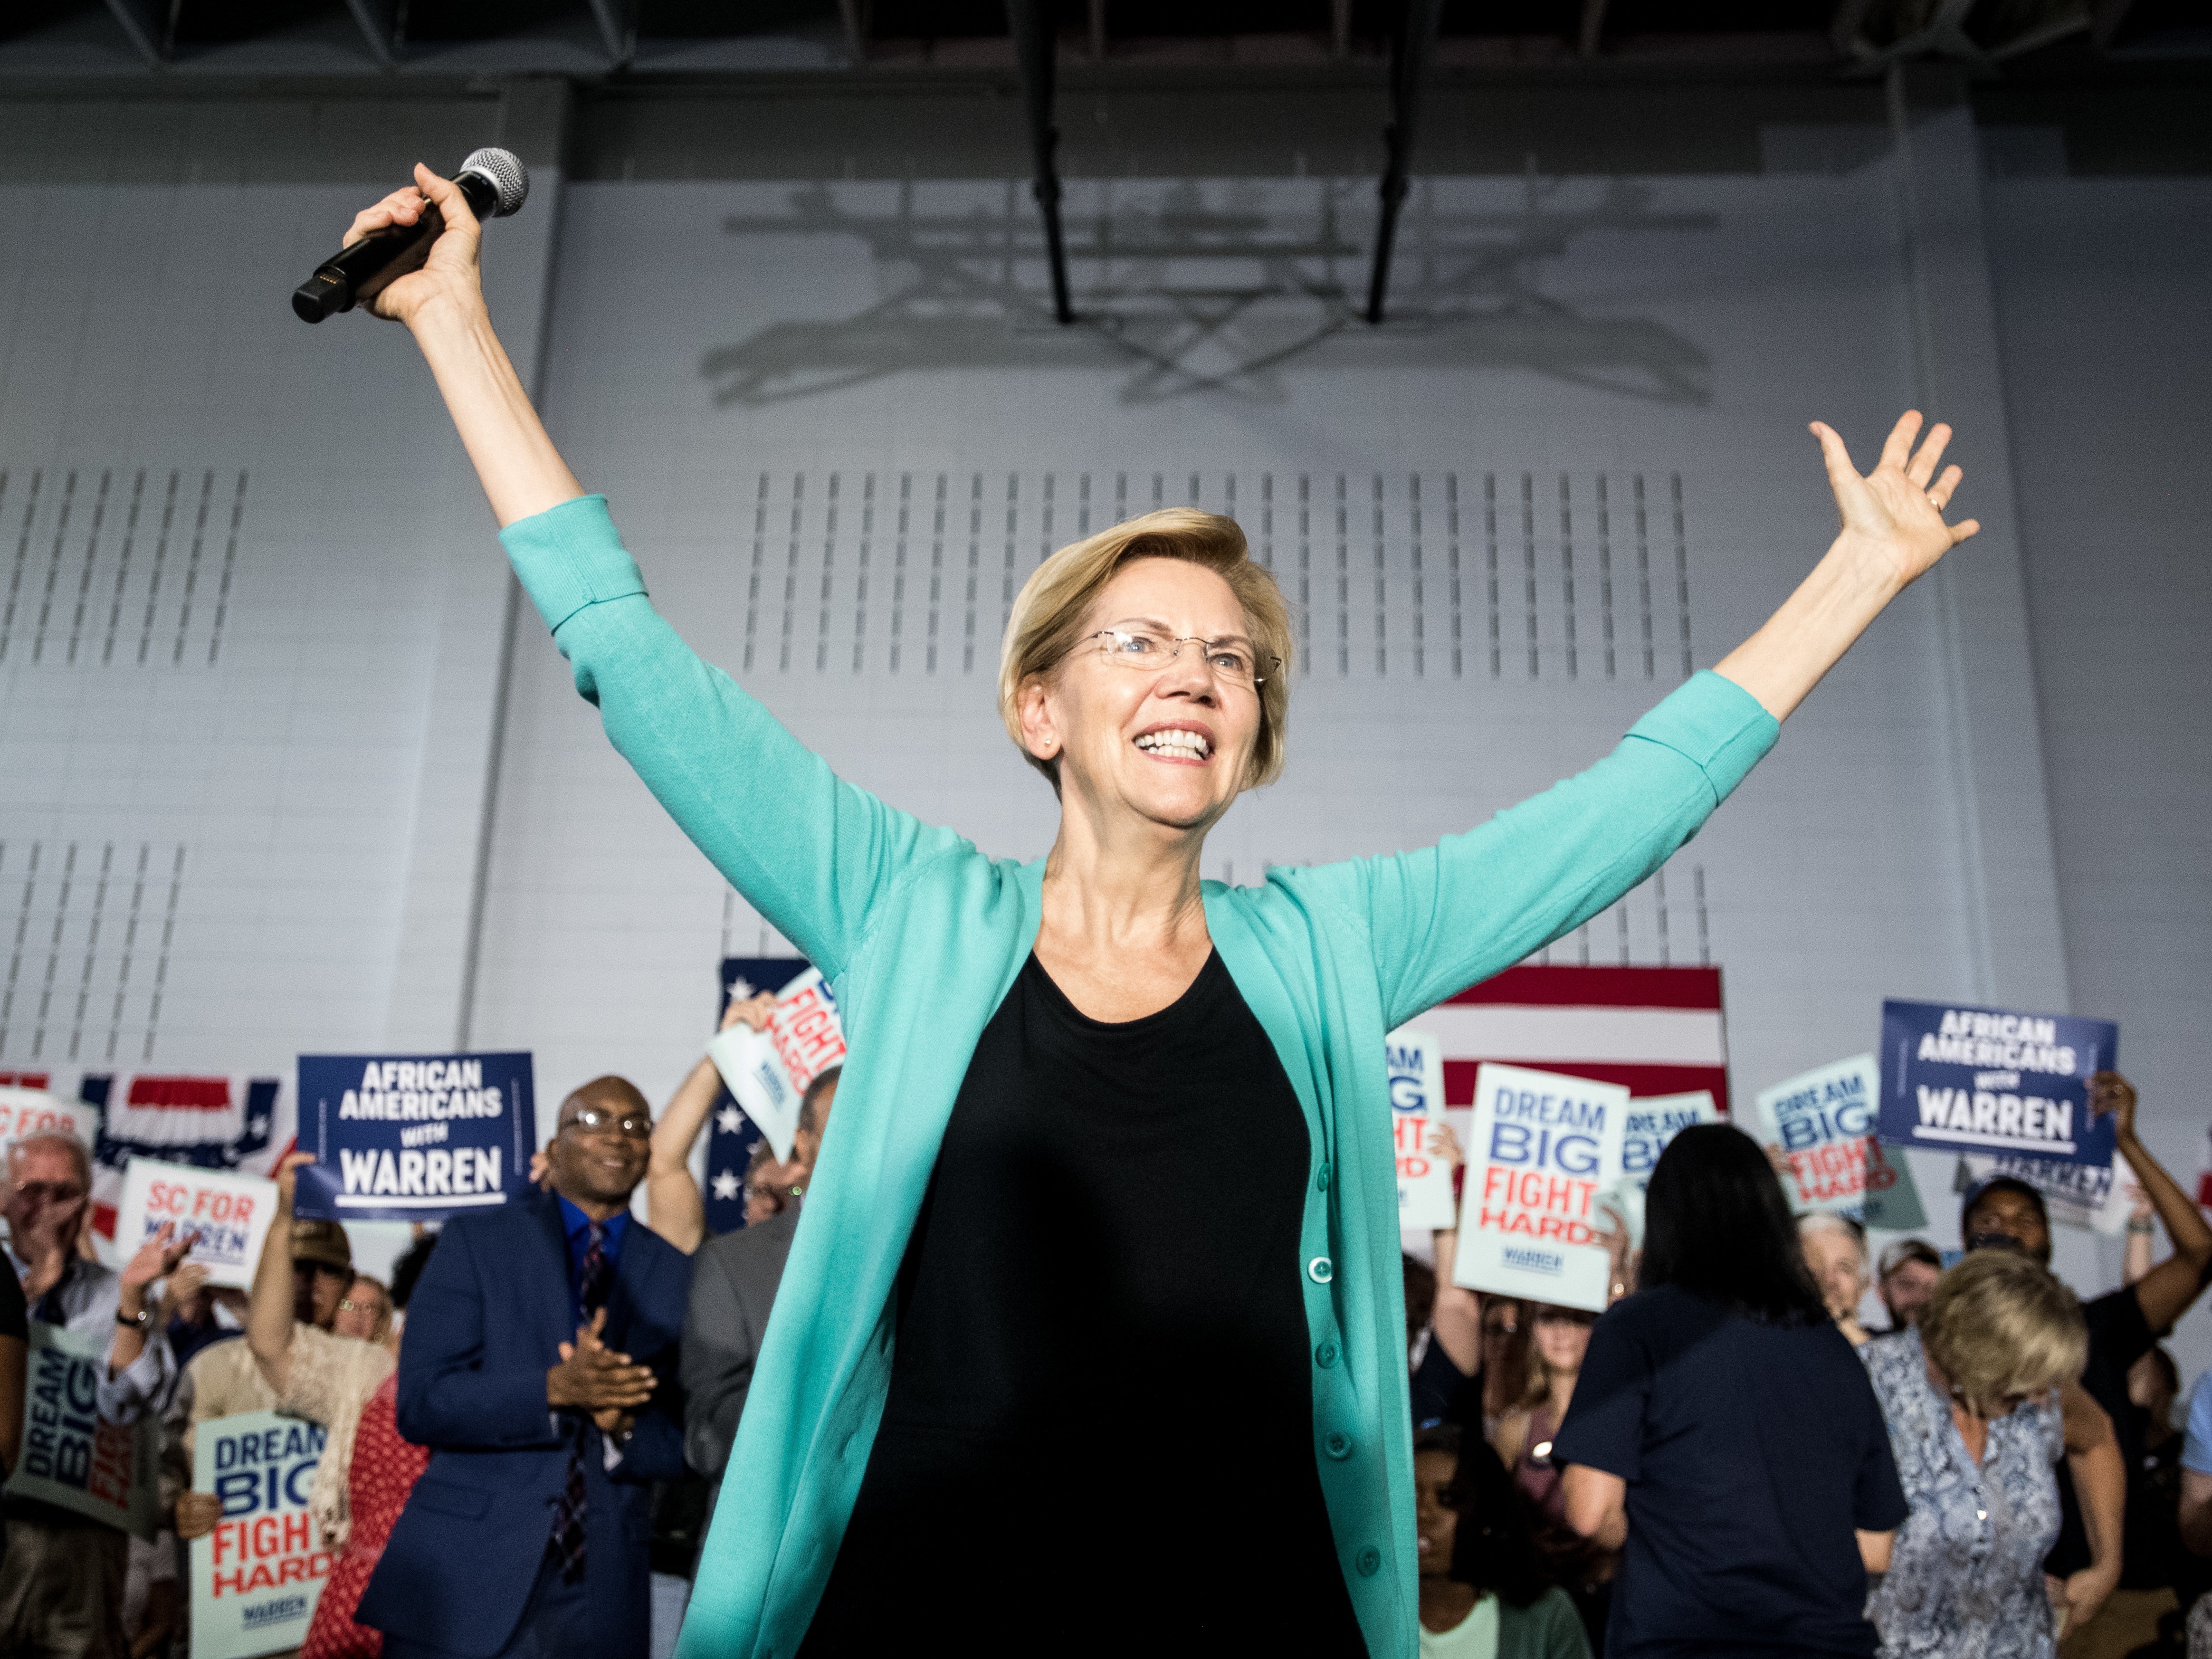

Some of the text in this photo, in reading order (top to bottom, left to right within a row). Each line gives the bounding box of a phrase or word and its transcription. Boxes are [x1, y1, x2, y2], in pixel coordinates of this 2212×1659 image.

[777, 989, 846, 1070] FIGHT
[1939, 1010, 2056, 1045] AFRICAN
[361, 1060, 483, 1091] AFRICAN
[1918, 1033, 2076, 1076] AMERICANS
[339, 1087, 503, 1120] AMERICANS
[1495, 1087, 1607, 1132] DREAM
[1916, 1084, 2074, 1141] WARREN
[400, 1122, 448, 1148] WITH
[1489, 1121, 1600, 1176] BIG
[1782, 1102, 1873, 1153] BIG
[339, 1146, 503, 1195] WARREN
[1484, 1165, 1599, 1216] FIGHT
[146, 1179, 255, 1224] SC FOR
[1479, 1207, 1594, 1245] HARD
[24, 1346, 67, 1478] DREAM
[56, 1359, 96, 1489] BIG
[215, 1425, 328, 1470] DREAM
[212, 1513, 312, 1566] FIGH
[212, 1552, 334, 1599] HARD
